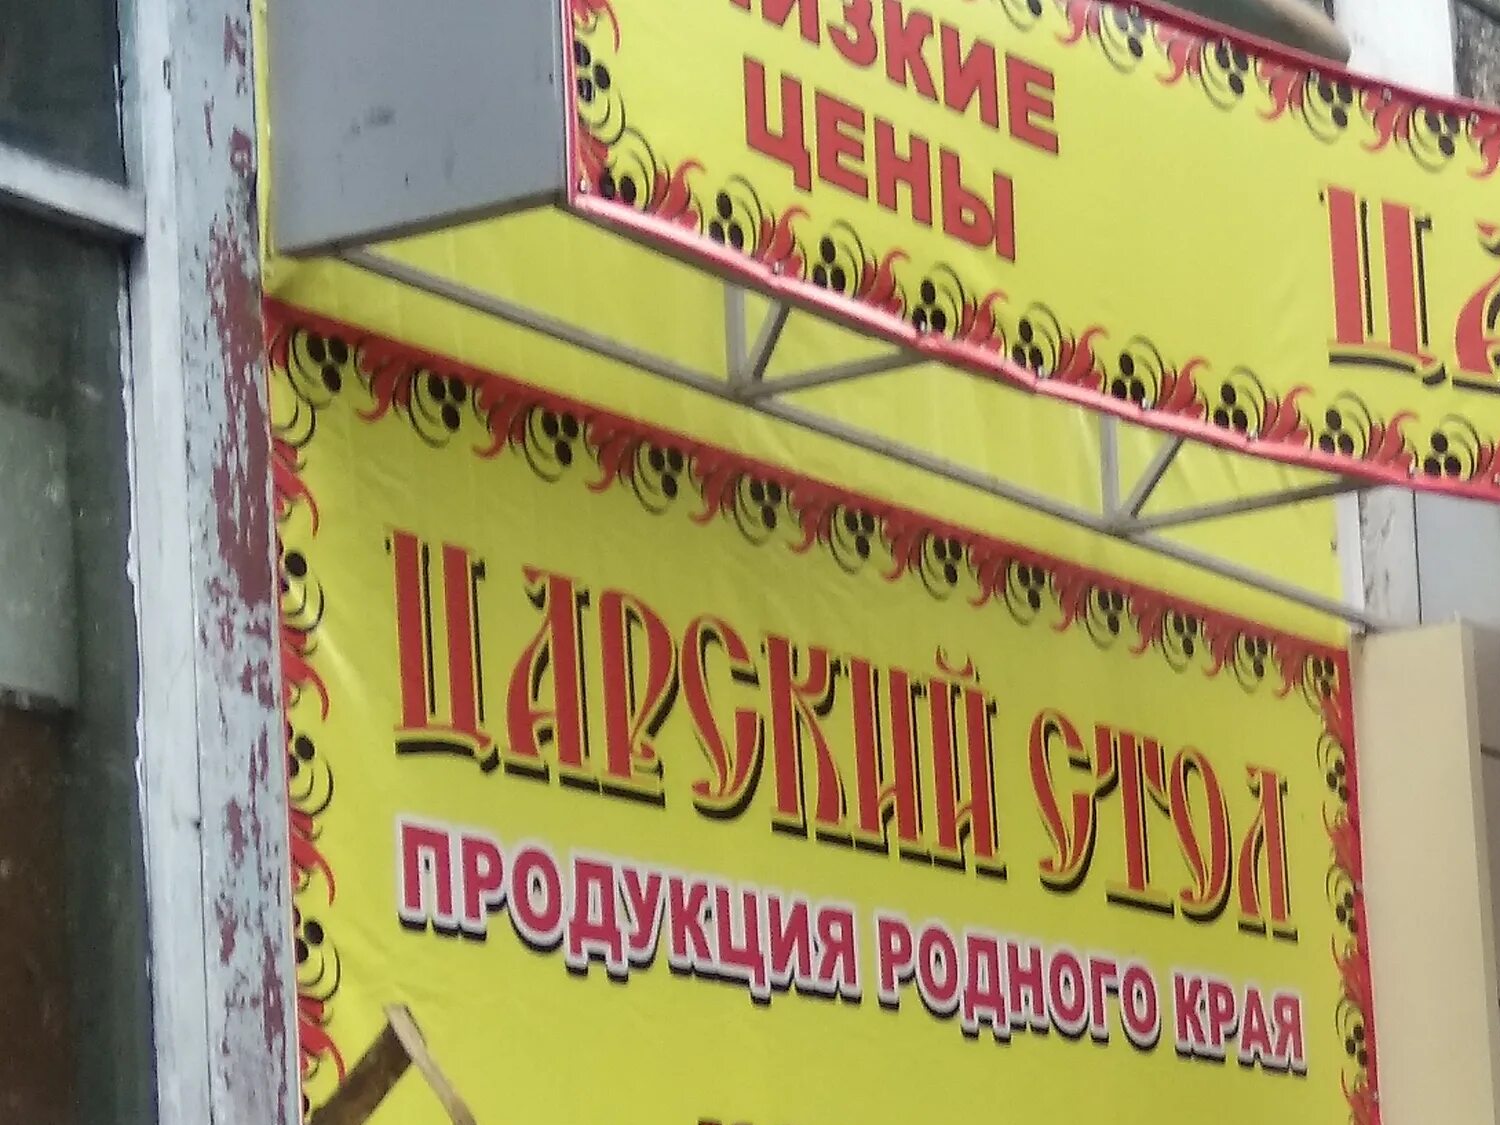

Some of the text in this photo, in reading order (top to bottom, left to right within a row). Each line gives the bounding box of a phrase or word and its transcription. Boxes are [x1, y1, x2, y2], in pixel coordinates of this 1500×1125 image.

[729, 0, 1060, 155] ЗКИЕ
[743, 55, 1017, 265] ЦЕНЫ
[385, 527, 1299, 942] ЦАРСКИЙ СТОЛ
[398, 818, 1309, 1075] ПРОДУКЦИЯ РОДНОГО КРАЯ
